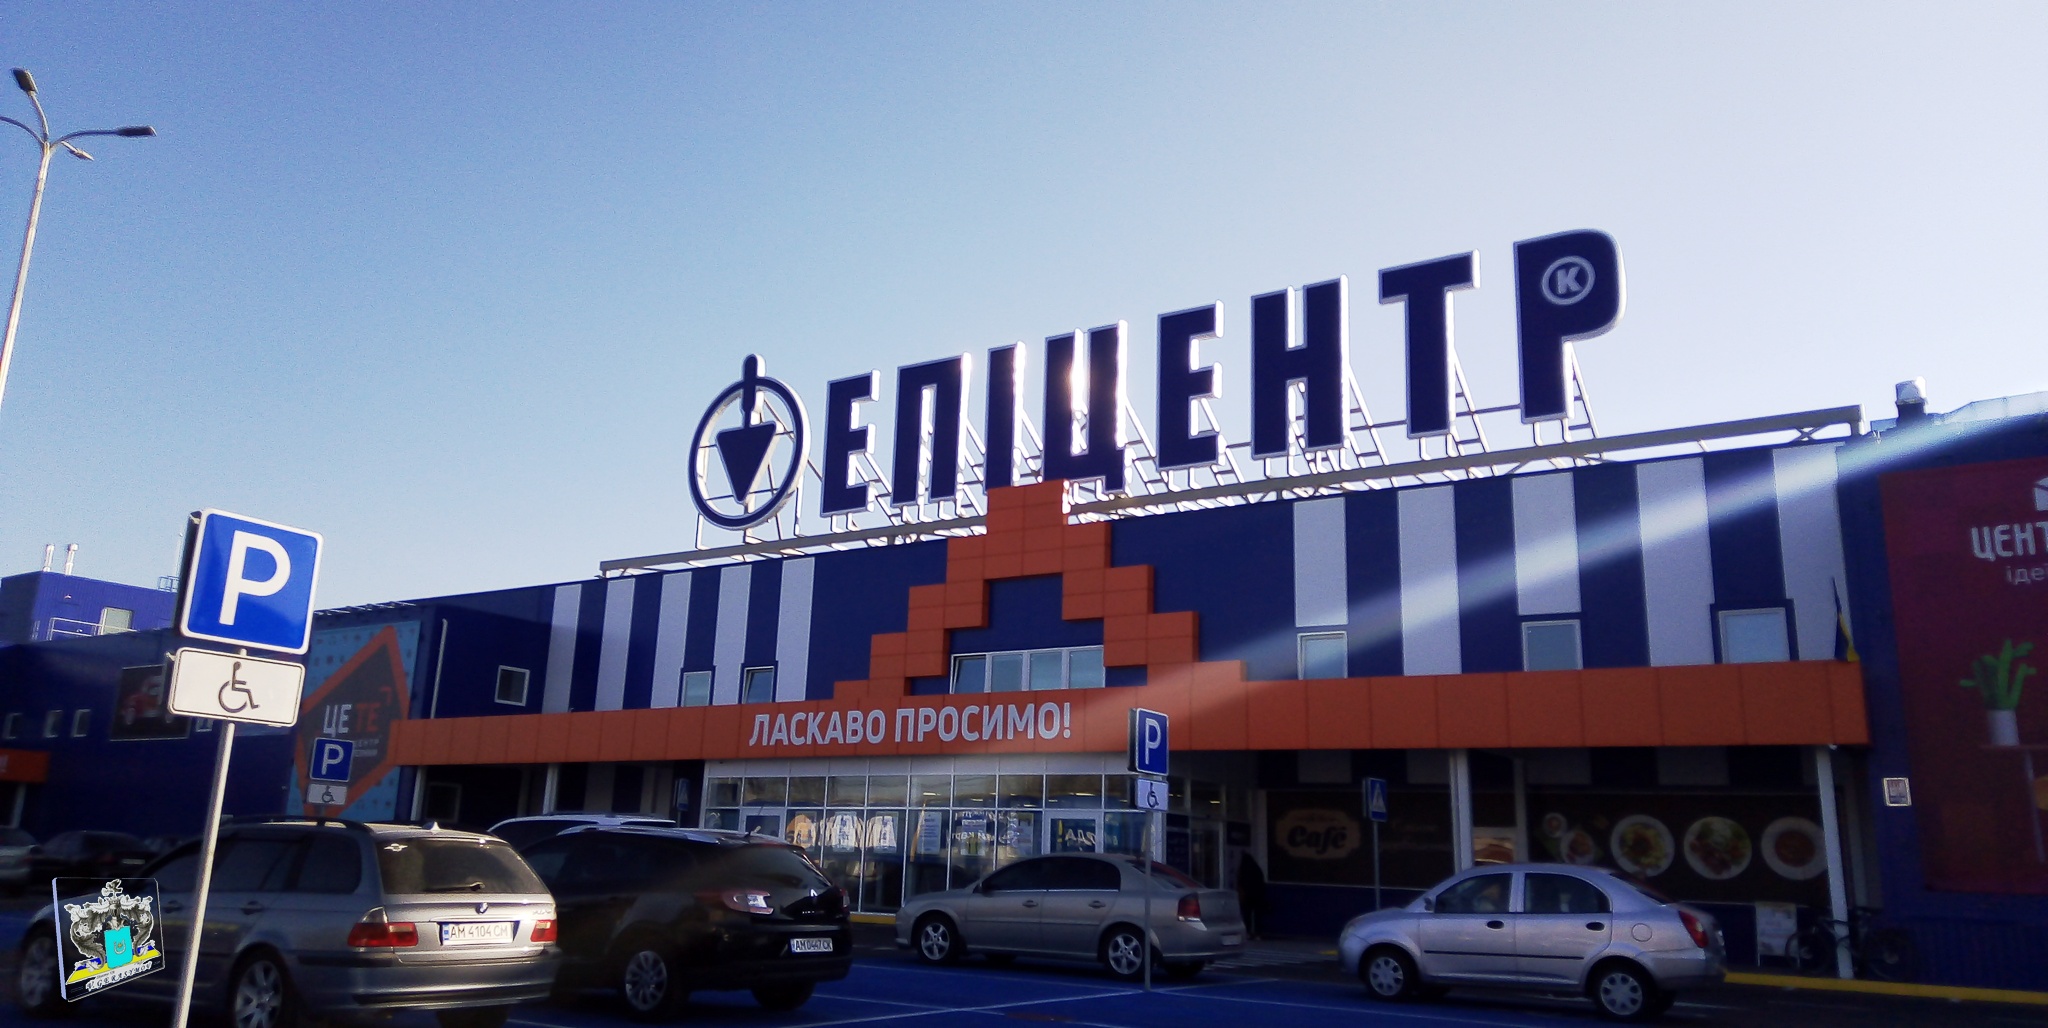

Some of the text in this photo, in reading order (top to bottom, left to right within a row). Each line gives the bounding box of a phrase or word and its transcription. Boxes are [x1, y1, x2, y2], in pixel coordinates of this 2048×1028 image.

[820, 229, 1627, 517] ЕПІЦЕНТР
[219, 530, 291, 625] P
[323, 704, 352, 738] ЦЕ
[749, 702, 1071, 746] ЛАСКАВО ПРОСИМО!
[1145, 718, 1161, 765] P
[321, 743, 344, 775] P
[450, 926, 466, 938] AM
[468, 925, 491, 938] 4104
